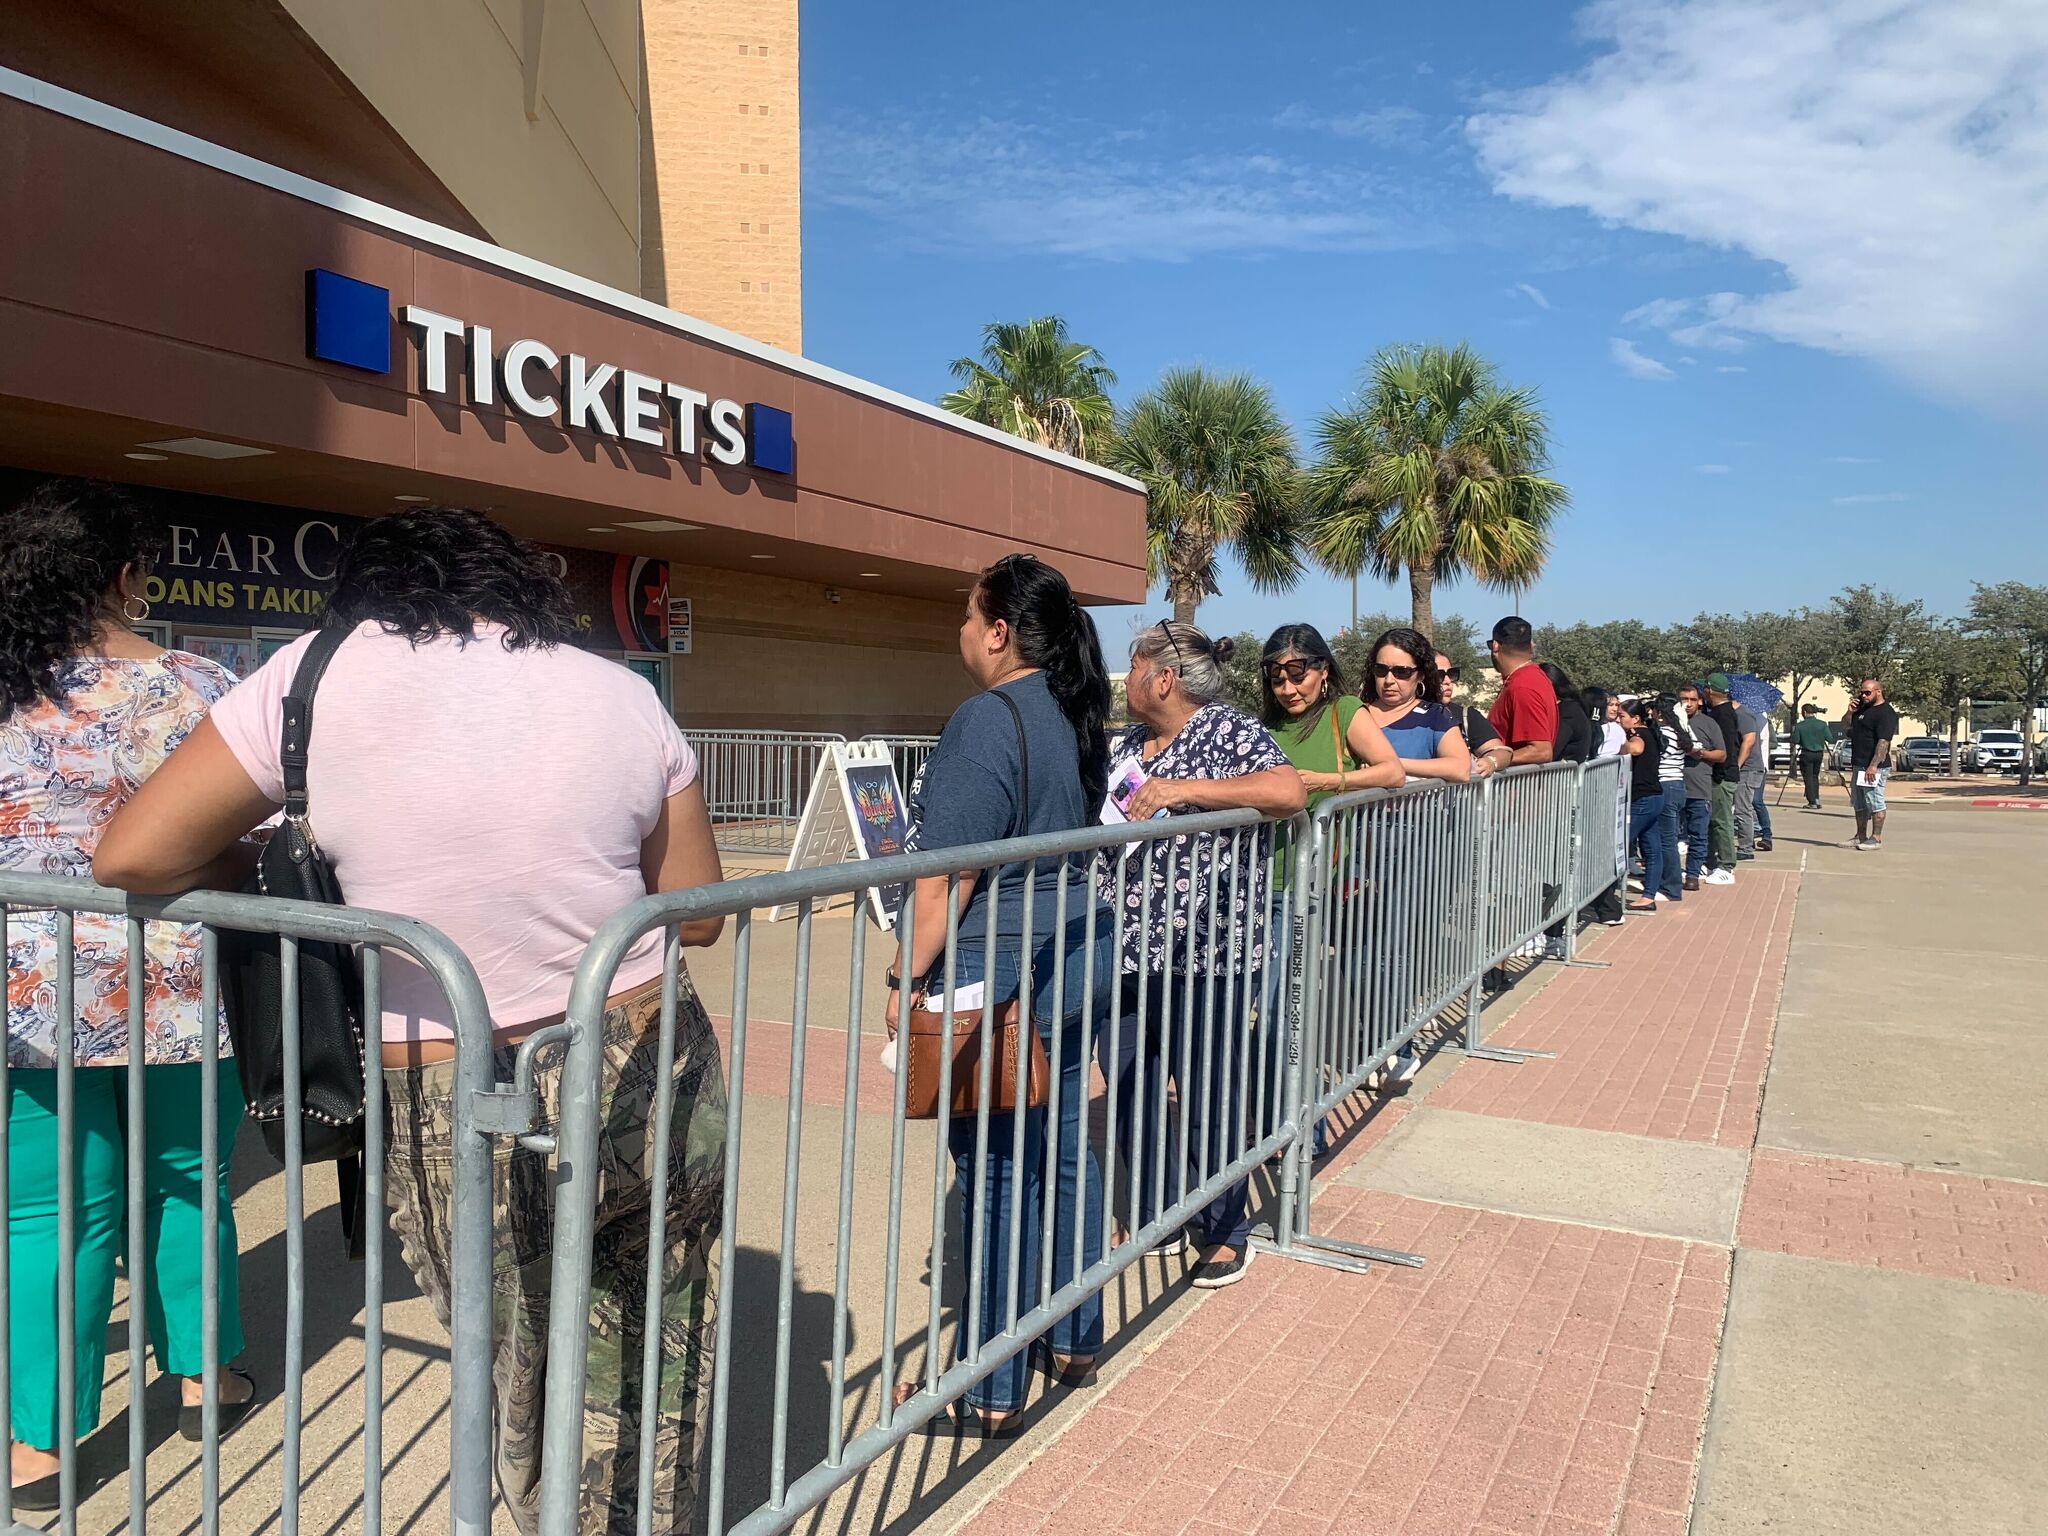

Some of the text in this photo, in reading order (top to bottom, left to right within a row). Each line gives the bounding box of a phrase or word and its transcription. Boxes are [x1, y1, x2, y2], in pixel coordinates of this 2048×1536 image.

[403, 304, 746, 466] TICKETS
[145, 575, 328, 616] OANS TAKIN
[154, 524, 281, 576] EAR
[1288, 914, 1304, 1067] FRIEDRICHS 800-394-9294
